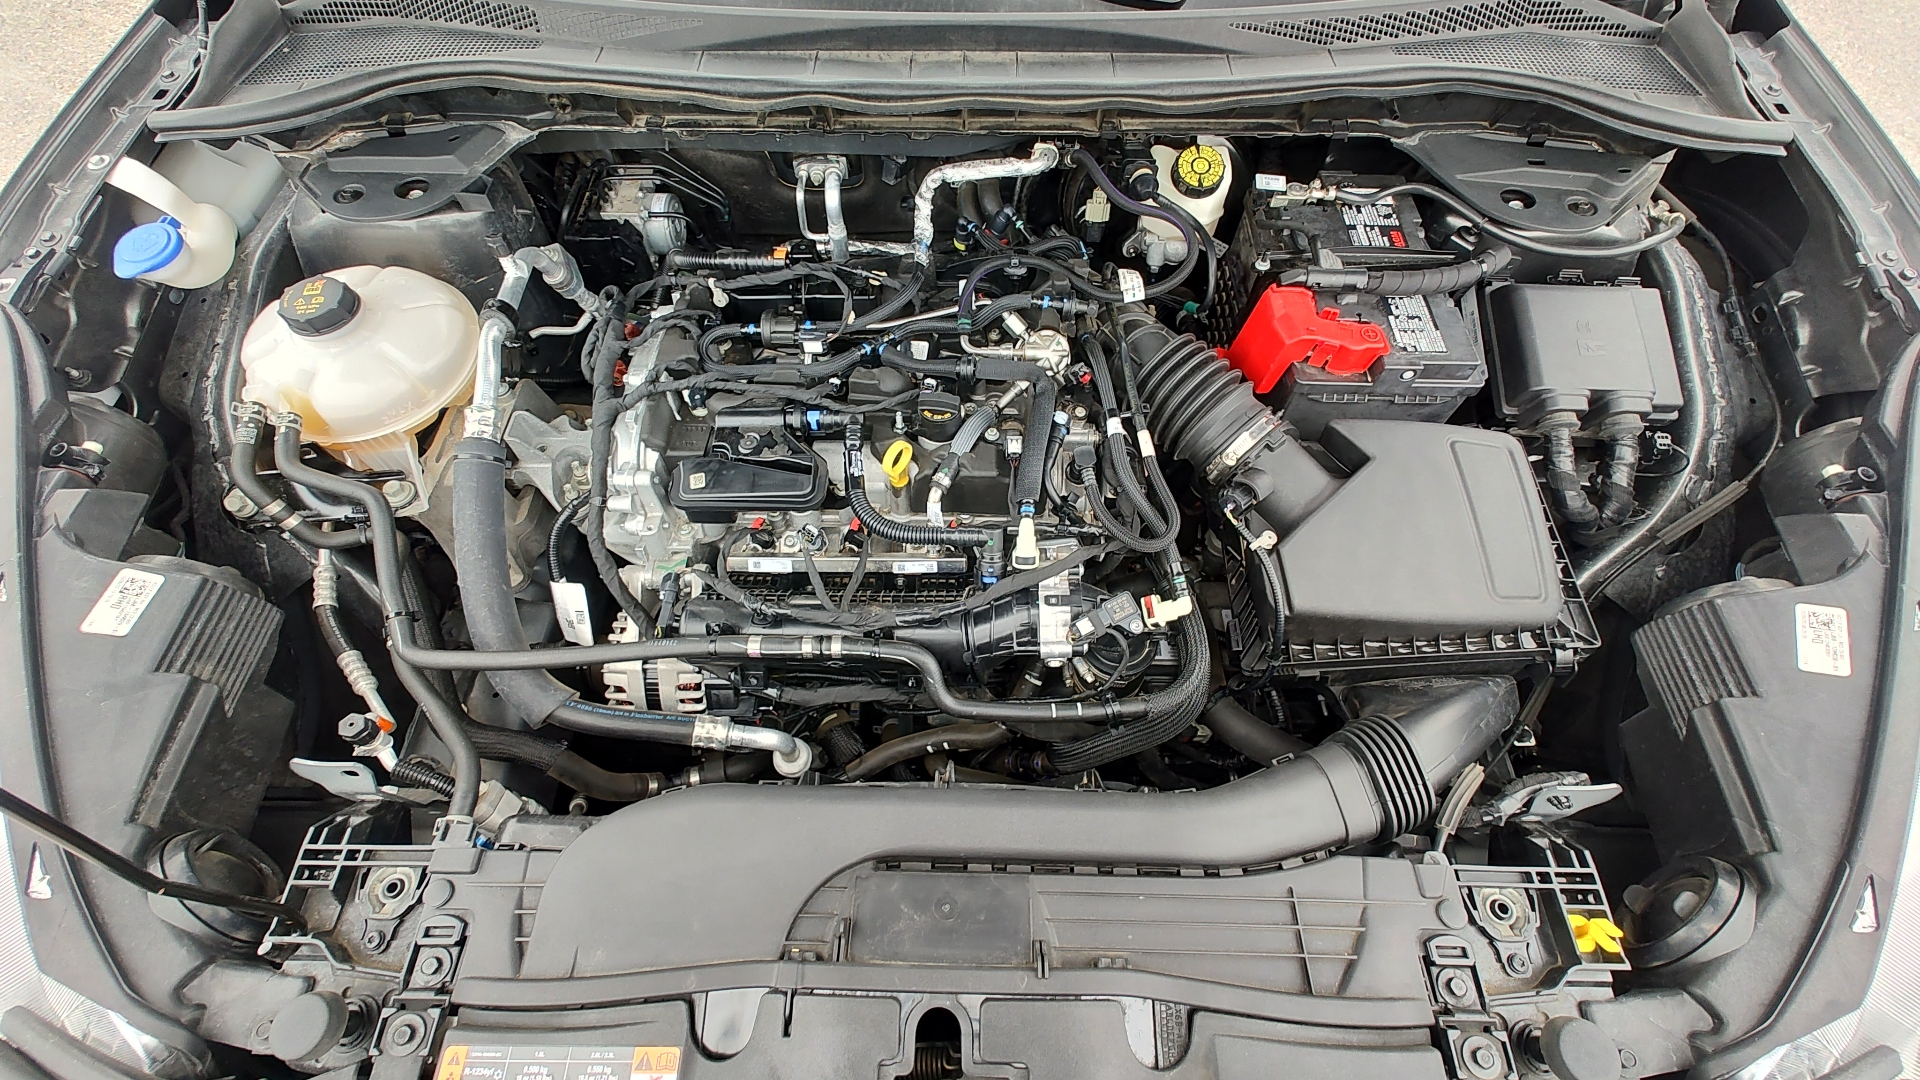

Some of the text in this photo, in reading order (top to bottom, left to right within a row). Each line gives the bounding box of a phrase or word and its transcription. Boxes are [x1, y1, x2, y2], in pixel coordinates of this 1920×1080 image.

[463, 1067, 496, 1078] R-1234yf
[540, 1065, 549, 1076] kg
[603, 1065, 612, 1075] kg
